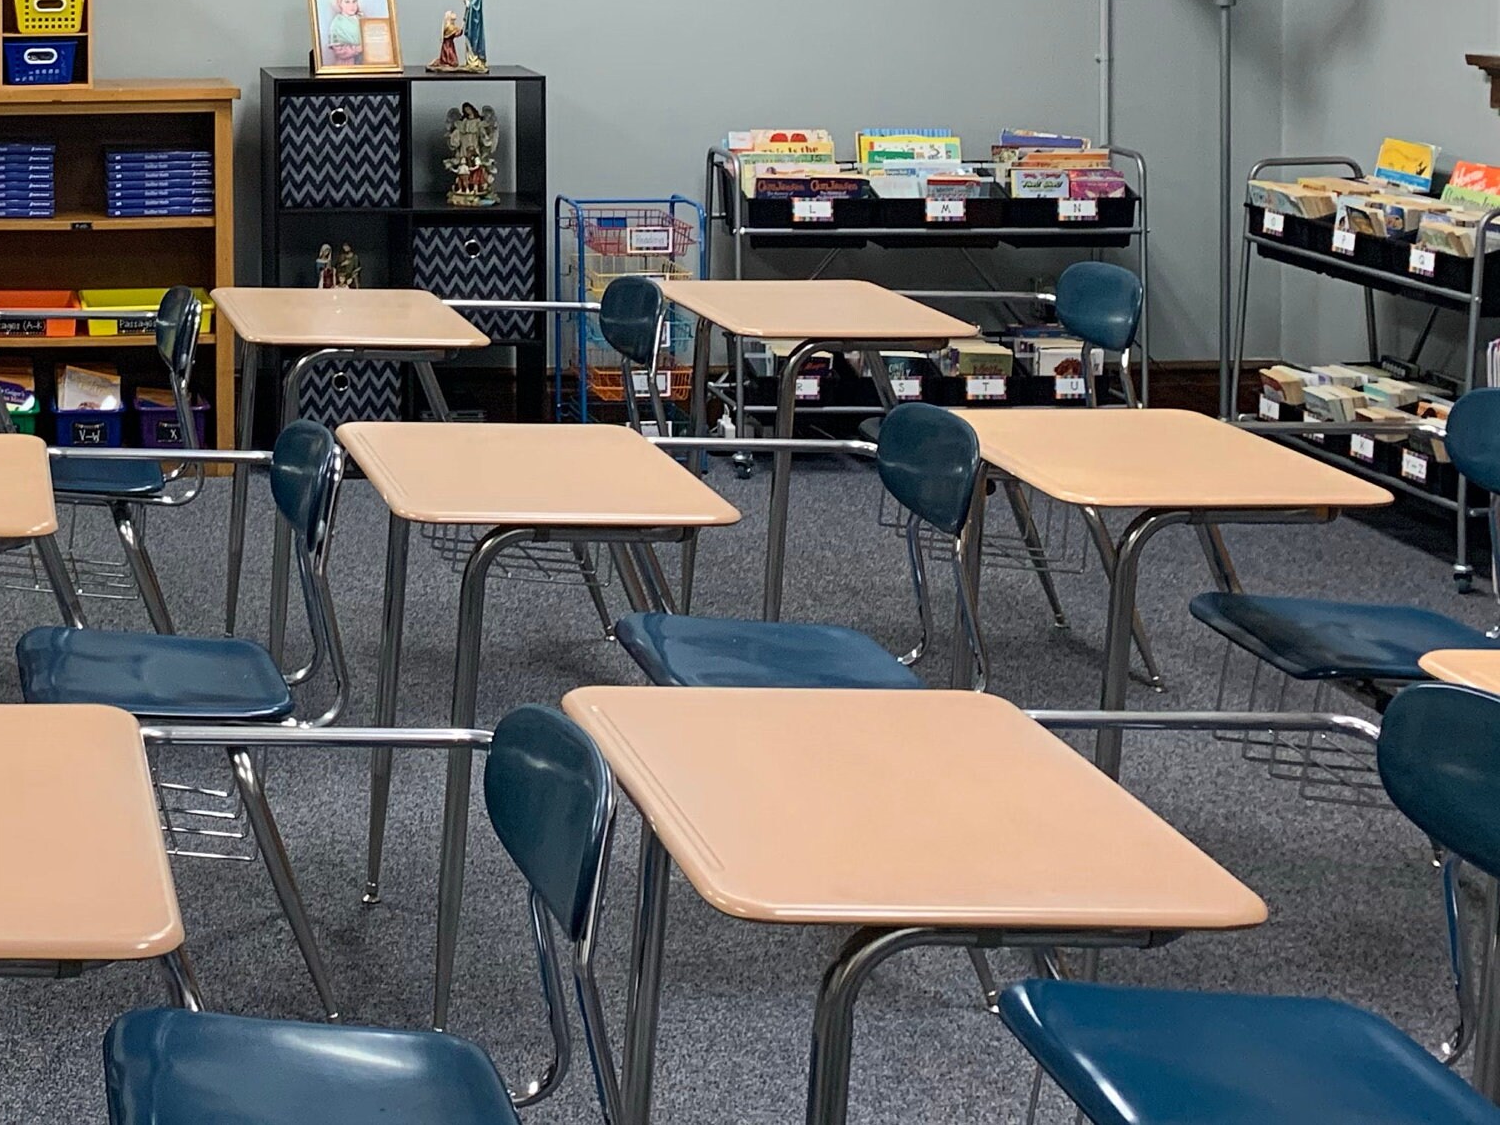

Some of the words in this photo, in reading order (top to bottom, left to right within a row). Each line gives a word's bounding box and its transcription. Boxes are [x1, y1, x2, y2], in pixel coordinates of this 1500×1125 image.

[810, 204, 816, 214] L
[941, 204, 951, 214] M
[1074, 203, 1081, 213] N
[898, 382, 905, 393] S
[982, 382, 989, 392] T
[1070, 381, 1079, 391] U
